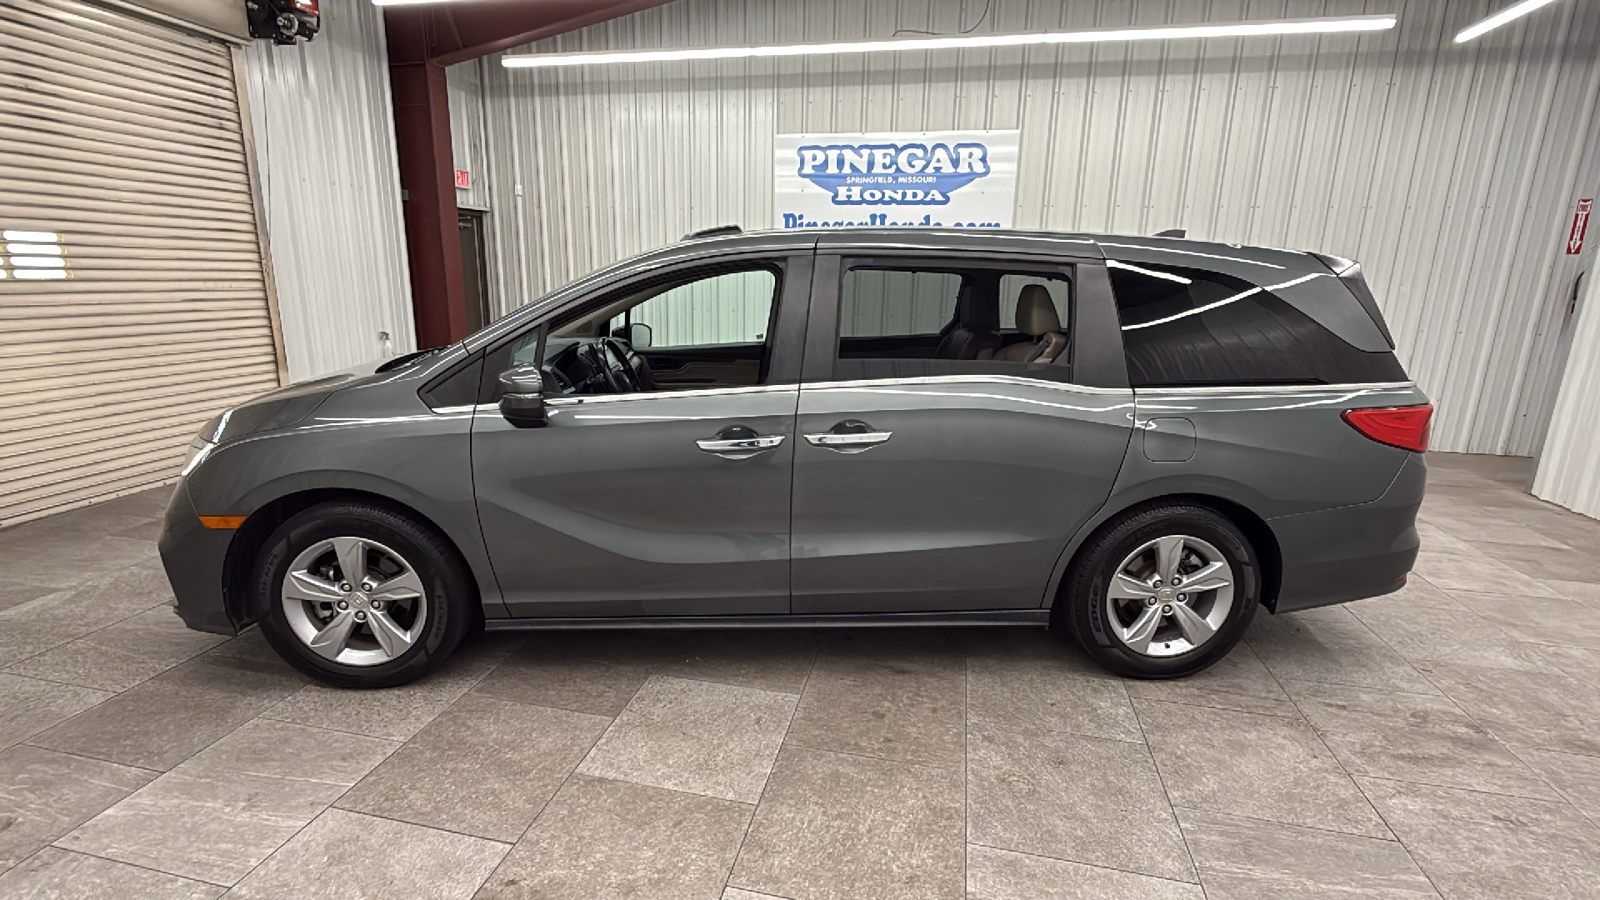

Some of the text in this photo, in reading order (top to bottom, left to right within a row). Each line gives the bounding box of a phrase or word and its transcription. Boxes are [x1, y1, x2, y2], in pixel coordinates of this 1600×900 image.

[801, 147, 986, 174] PINEGAR
[846, 176, 895, 184] SPRINGFIELD,
[835, 186, 945, 201] HONDA
